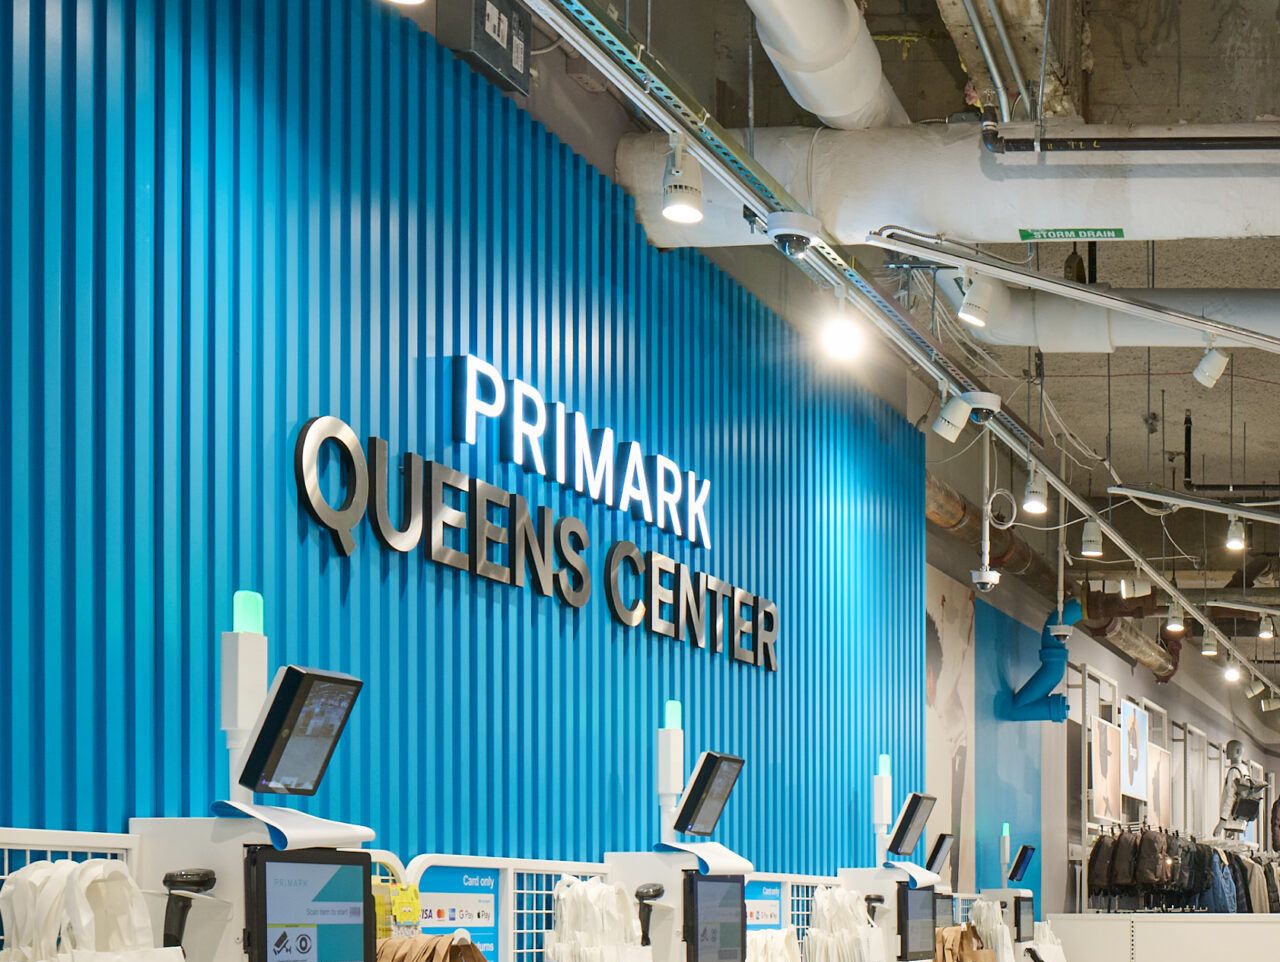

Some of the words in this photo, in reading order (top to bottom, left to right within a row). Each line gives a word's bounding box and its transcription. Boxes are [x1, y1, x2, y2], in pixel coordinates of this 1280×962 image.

[1033, 230, 1076, 239] STORM
[1078, 230, 1116, 238] DRAIN
[461, 353, 711, 550] PRIMARK
[294, 415, 592, 608] QUEENS
[604, 540, 778, 672] CENTER
[463, 874, 479, 887] Card
[480, 875, 495, 890] only
